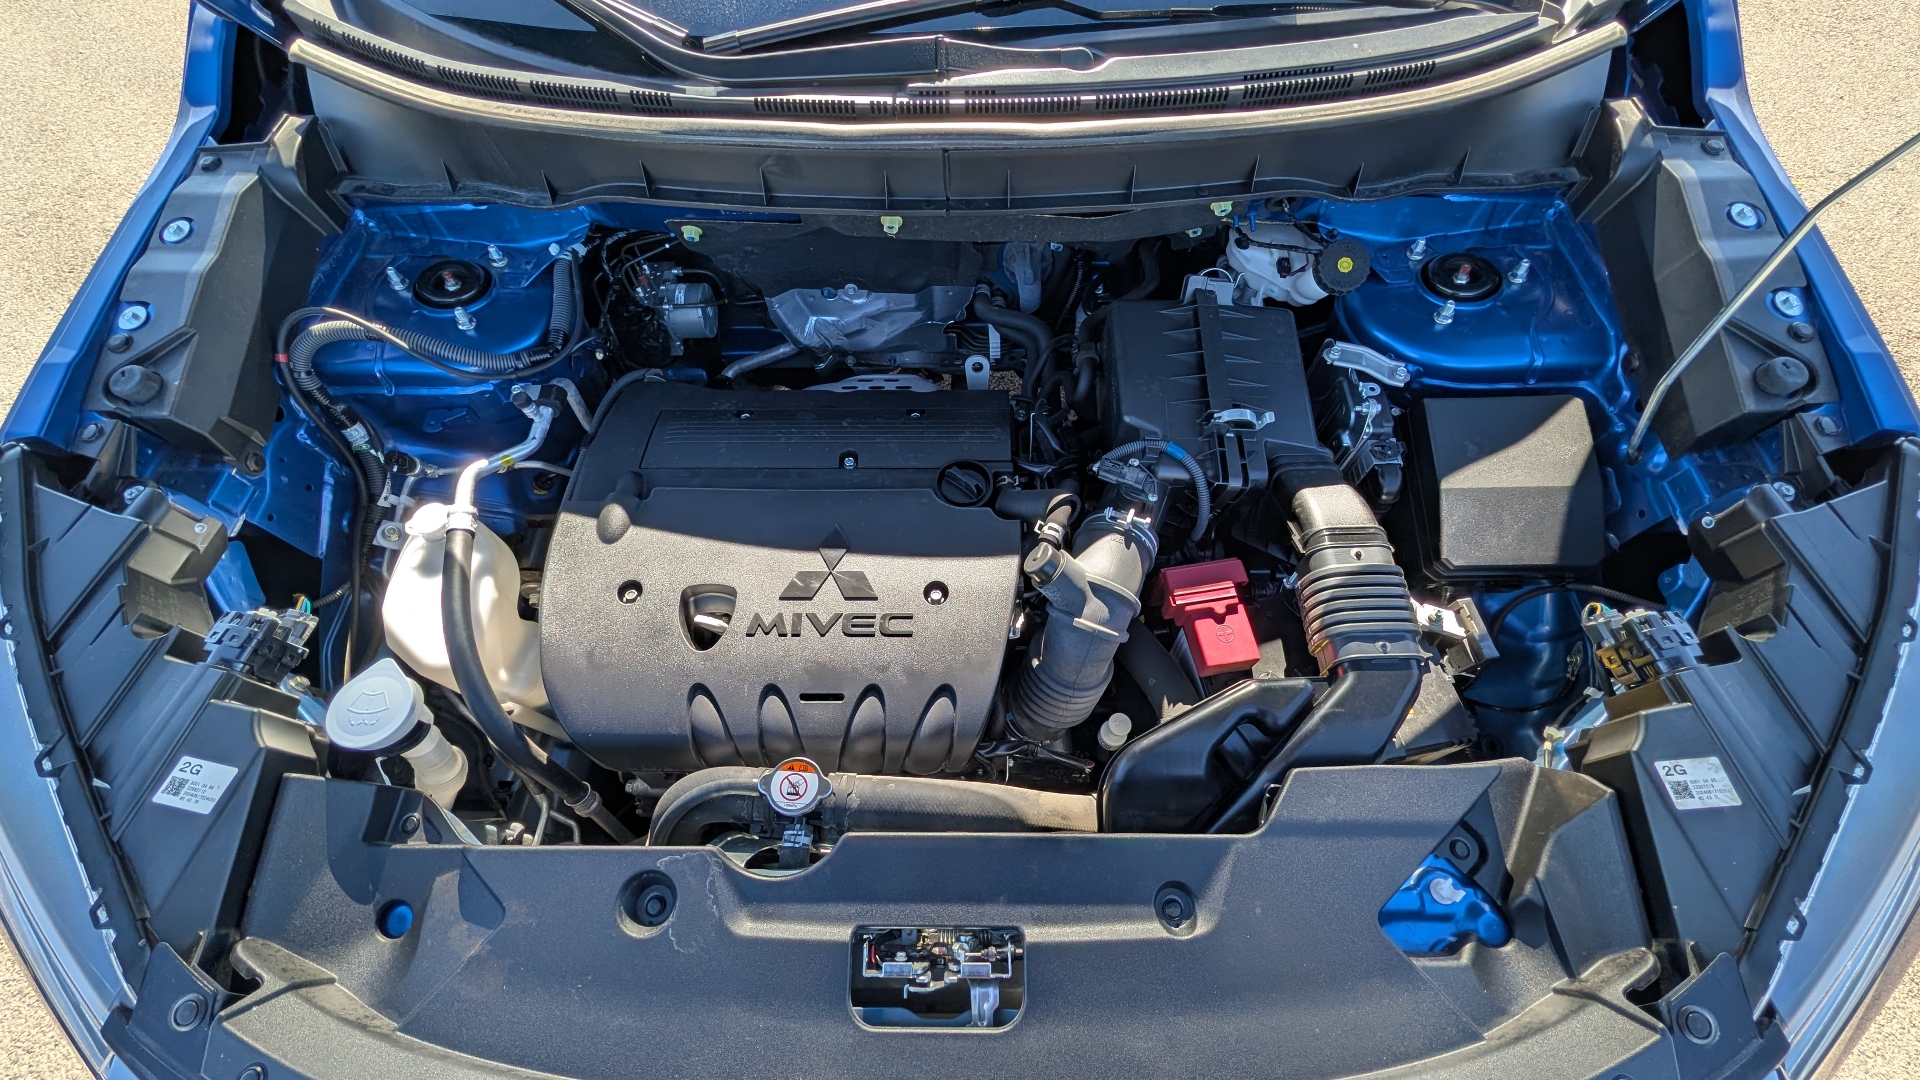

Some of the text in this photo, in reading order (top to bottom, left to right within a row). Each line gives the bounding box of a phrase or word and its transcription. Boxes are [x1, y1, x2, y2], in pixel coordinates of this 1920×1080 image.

[746, 613, 913, 637] MIVEC
[178, 761, 203, 776] 2G
[1662, 764, 1688, 777] 2G
